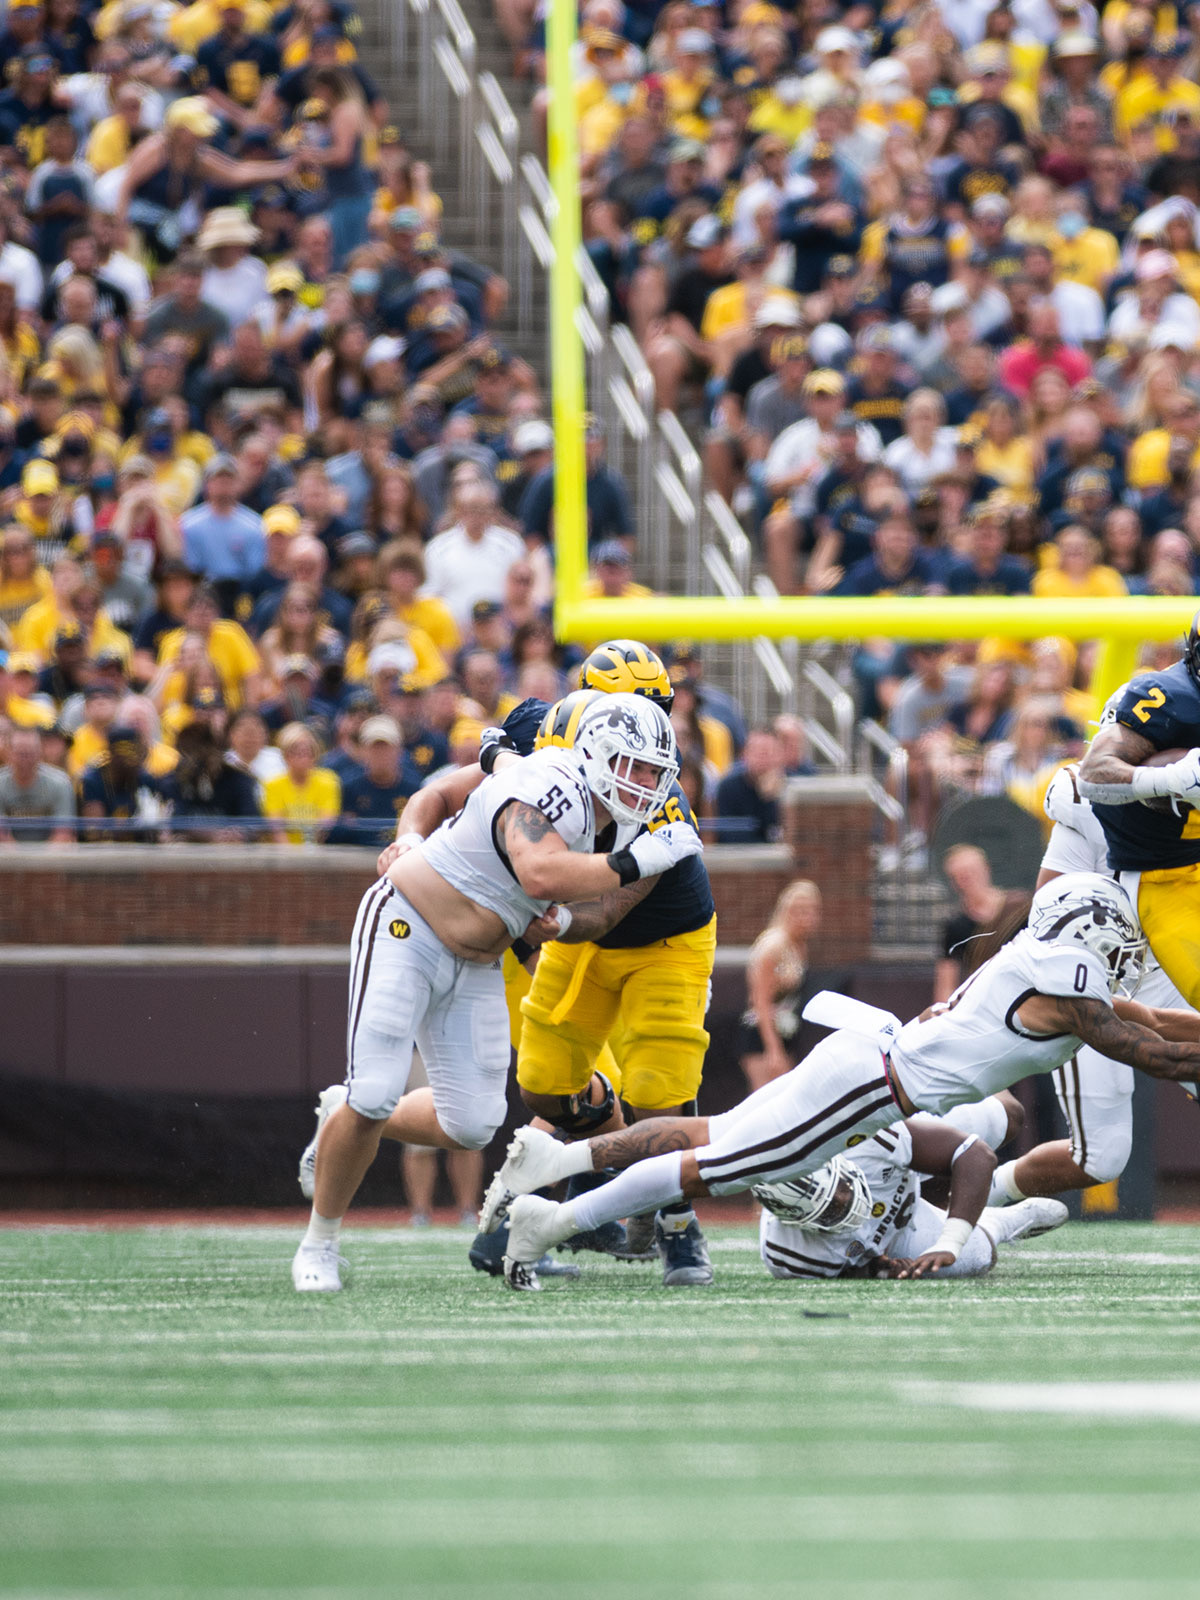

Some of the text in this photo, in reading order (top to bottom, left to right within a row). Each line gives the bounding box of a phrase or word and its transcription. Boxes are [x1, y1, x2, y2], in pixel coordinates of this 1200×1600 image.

[1132, 687, 1166, 723] 2
[537, 785, 573, 823] 55
[392, 922, 408, 937] W
[1074, 963, 1088, 993] 0
[873, 1203, 886, 1217] W
